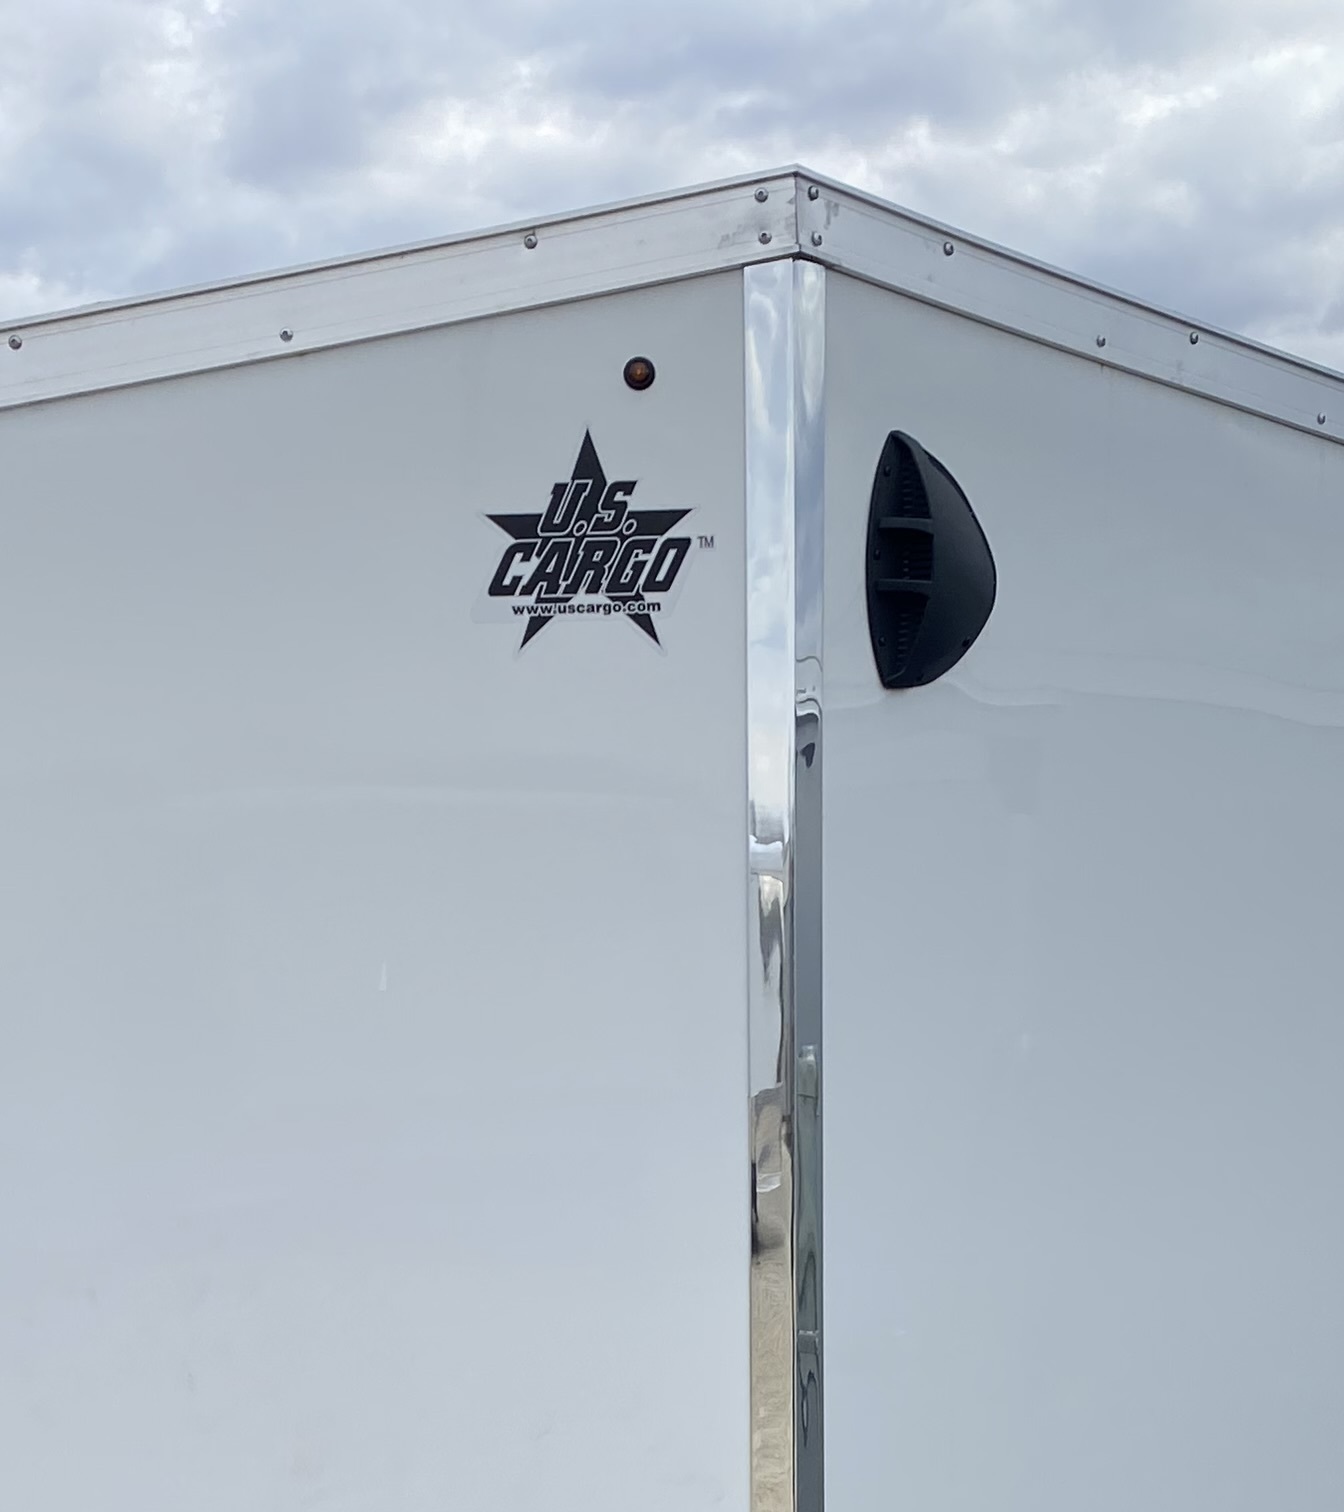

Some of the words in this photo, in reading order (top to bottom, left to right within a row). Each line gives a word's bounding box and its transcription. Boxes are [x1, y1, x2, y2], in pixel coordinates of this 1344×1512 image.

[537, 479, 638, 537] U.S.
[487, 537, 691, 597] CARGO
[512, 600, 662, 616] www.uscargo.com
